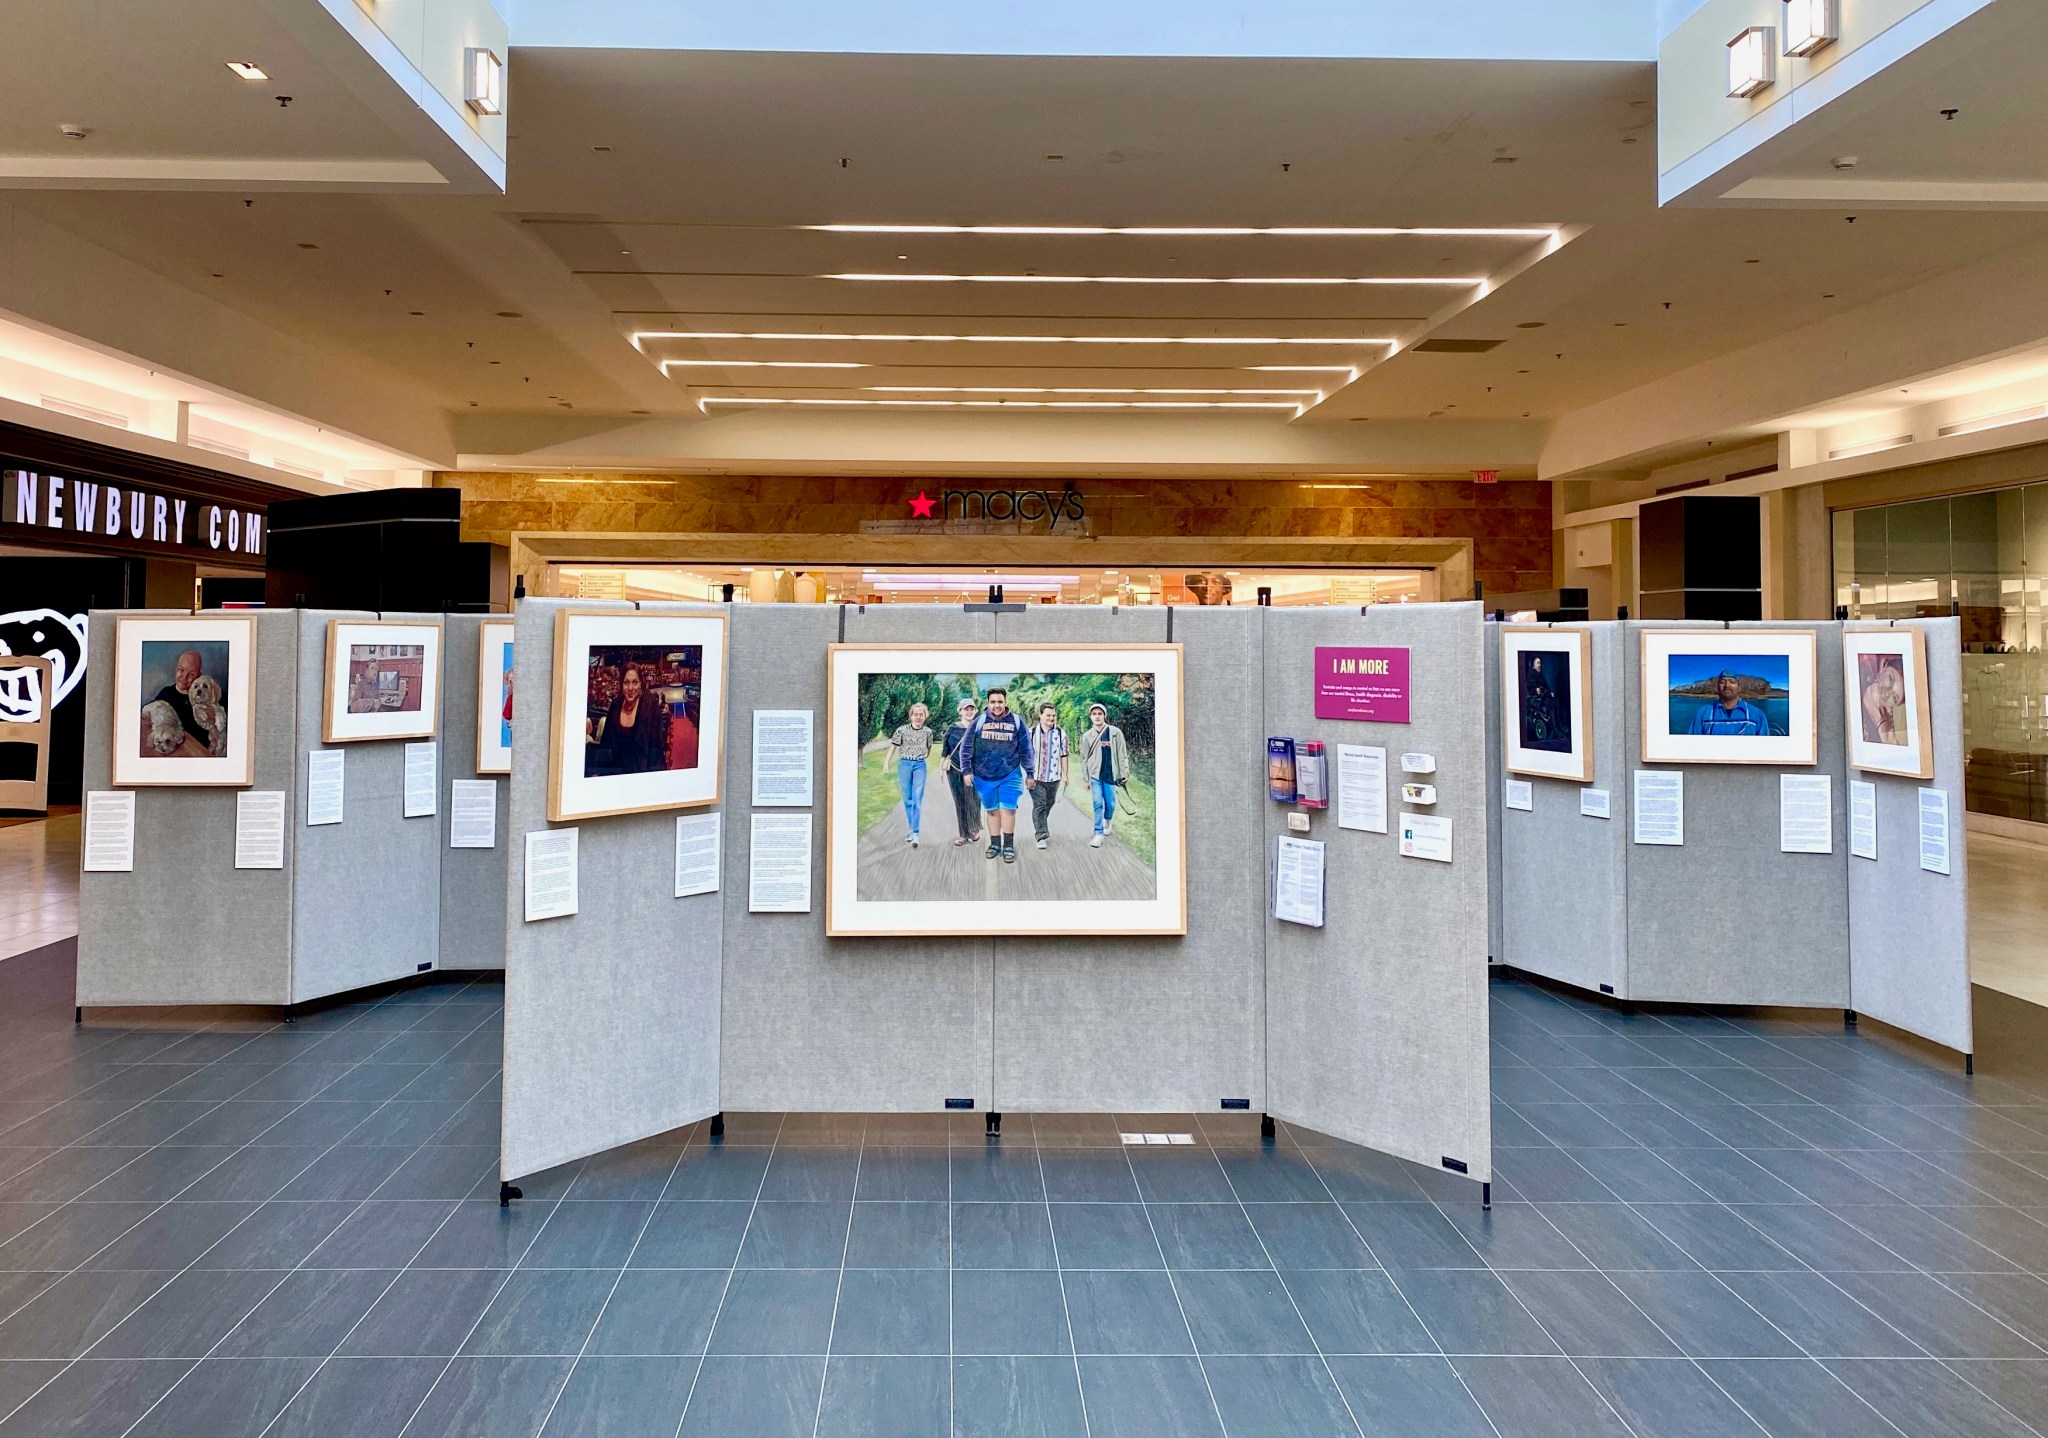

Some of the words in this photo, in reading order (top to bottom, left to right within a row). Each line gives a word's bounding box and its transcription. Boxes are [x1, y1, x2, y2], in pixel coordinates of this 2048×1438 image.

[16, 470, 187, 544] NEWBURY
[209, 505, 262, 555] COM
[1333, 659, 1337, 673] I
[1340, 659, 1355, 674] AM
[1359, 659, 1389, 674] MORE
